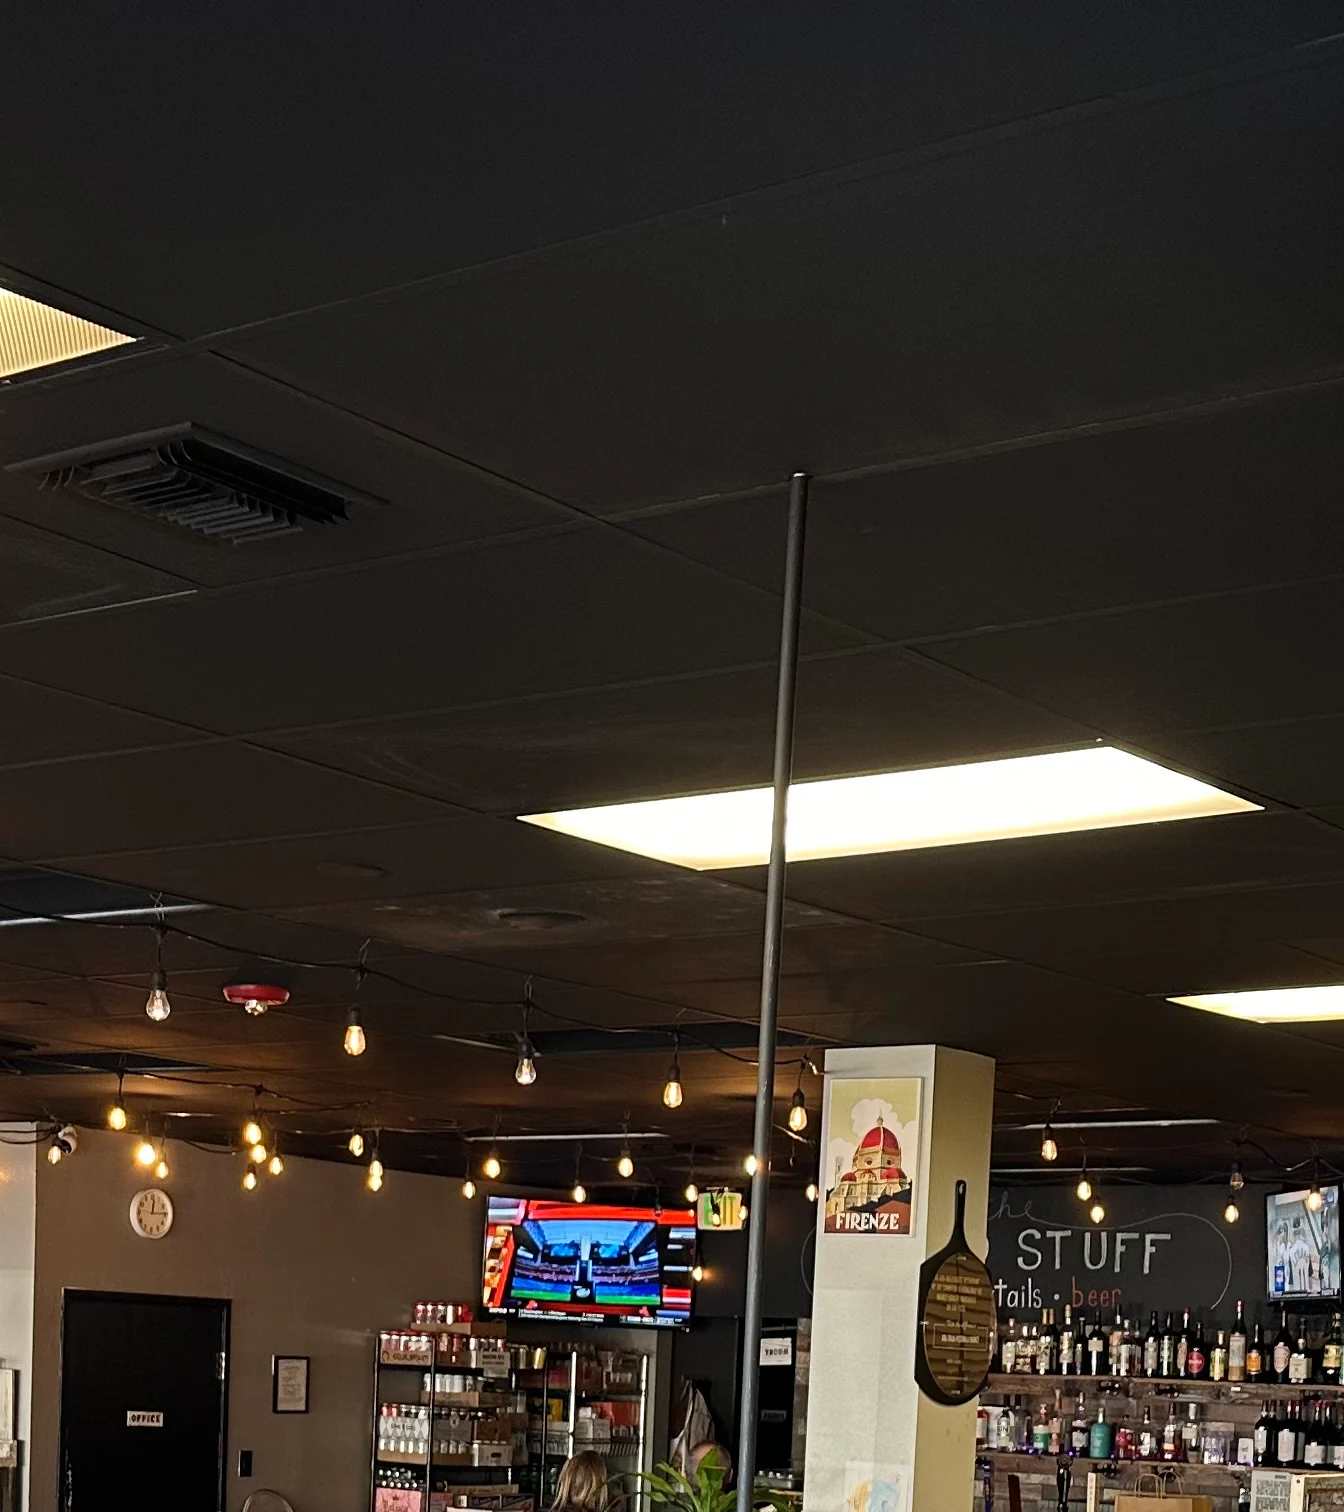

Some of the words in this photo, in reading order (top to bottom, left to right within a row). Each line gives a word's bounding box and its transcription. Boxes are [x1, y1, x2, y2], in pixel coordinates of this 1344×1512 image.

[835, 1212, 899, 1231] FIRENZE
[1016, 1228, 1171, 1274] STUFF
[992, 1277, 1043, 1309] tails
[1071, 1275, 1122, 1310] beer
[130, 1413, 161, 1424] OFFICE
